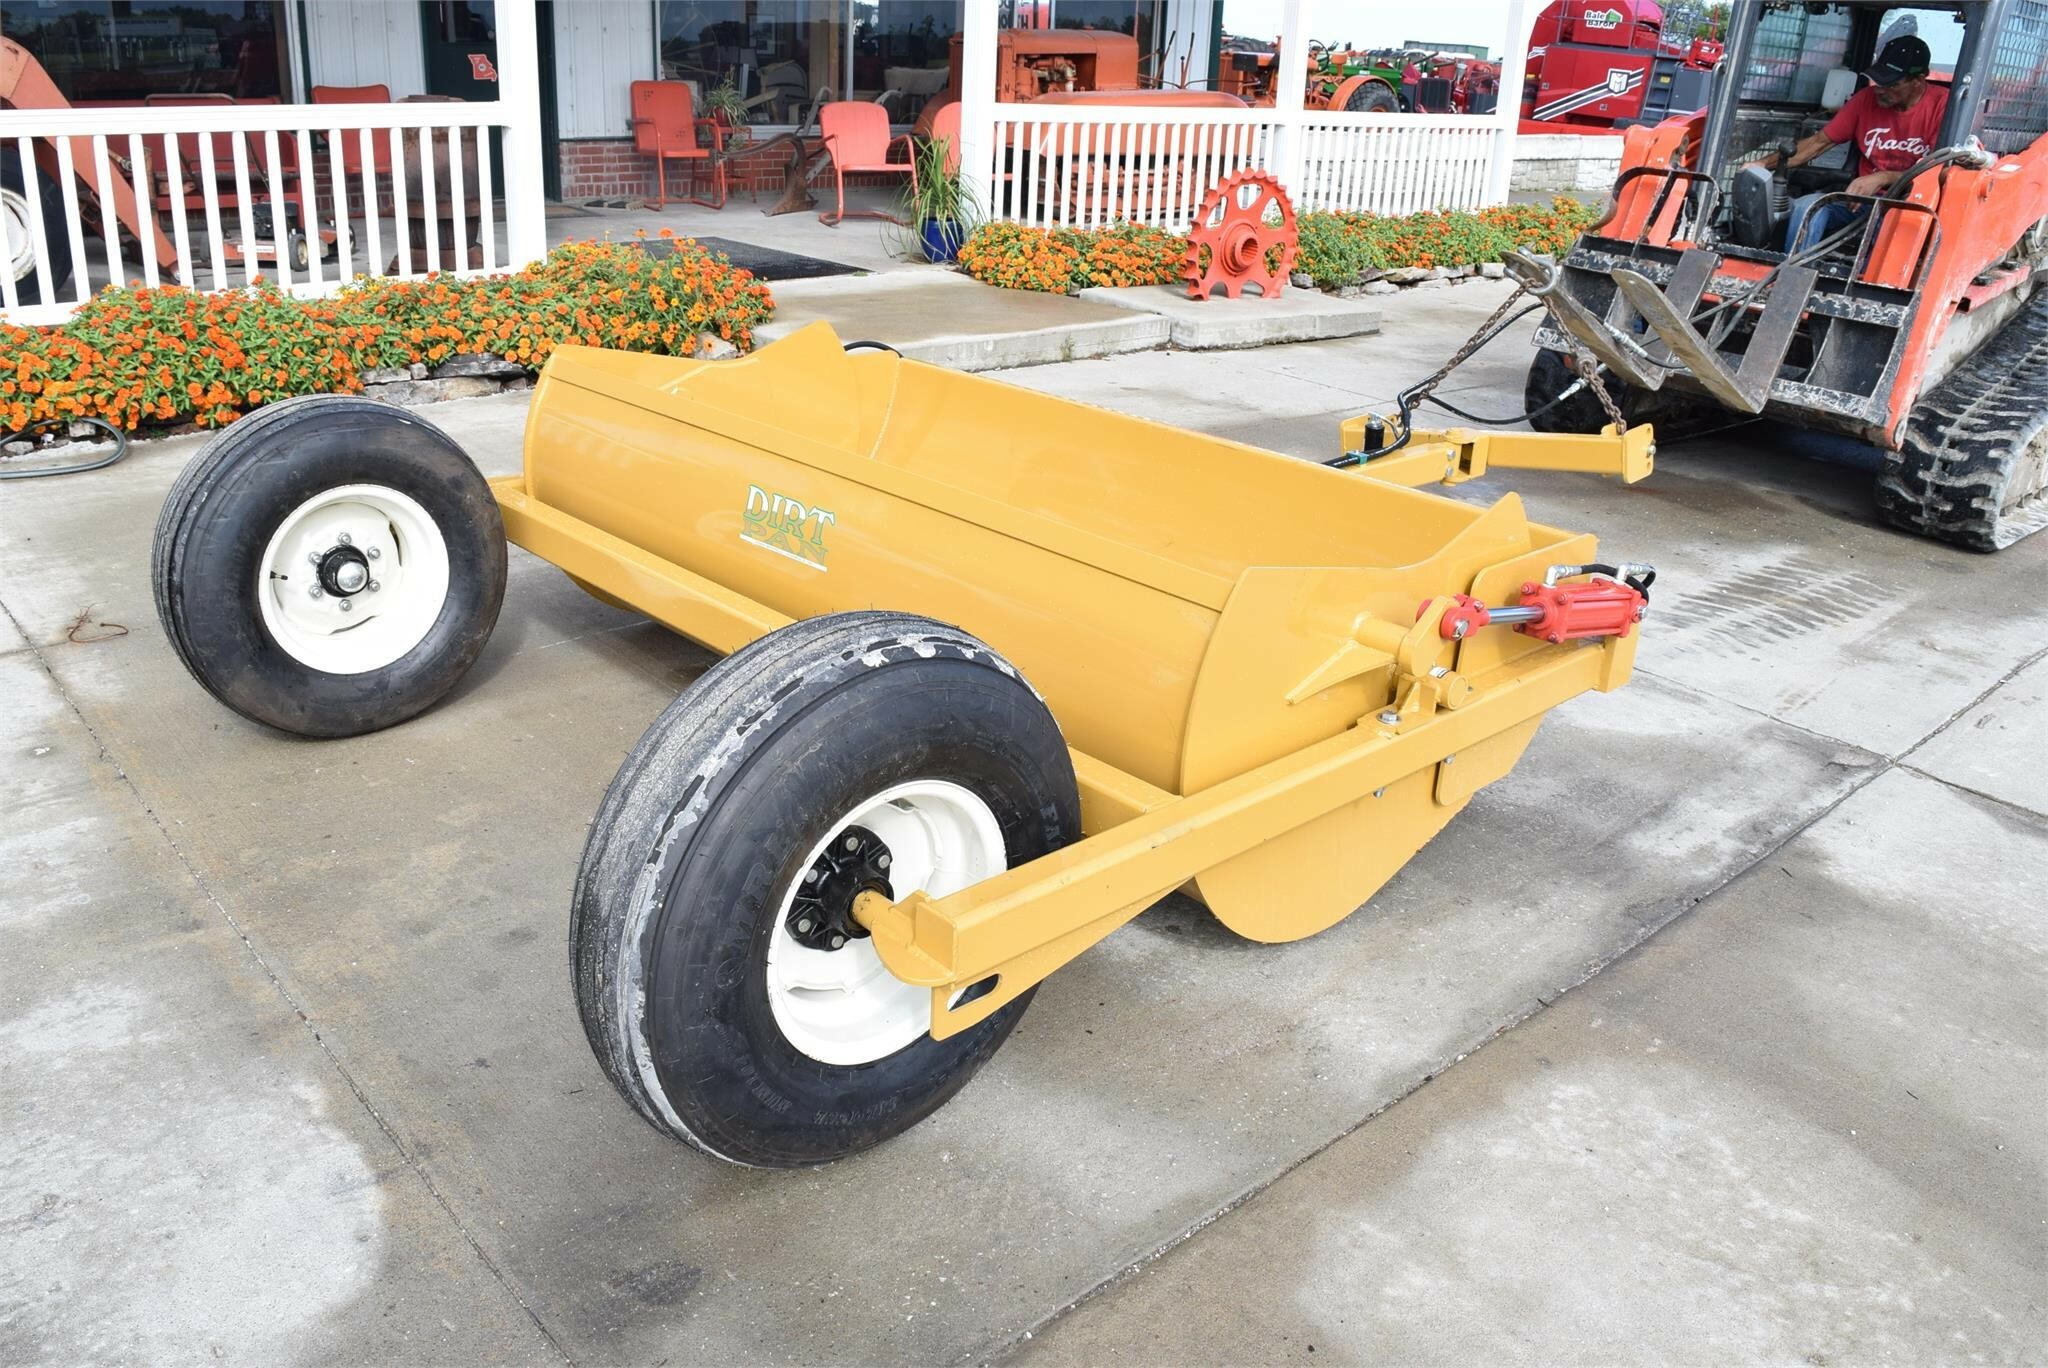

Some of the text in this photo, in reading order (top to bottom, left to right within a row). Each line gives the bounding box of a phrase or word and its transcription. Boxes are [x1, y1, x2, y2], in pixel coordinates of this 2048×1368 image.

[1585, 11, 1605, 20] Bale
[1587, 19, 1615, 28] Baron
[743, 484, 836, 545] DIRT
[741, 519, 828, 567] PAN
